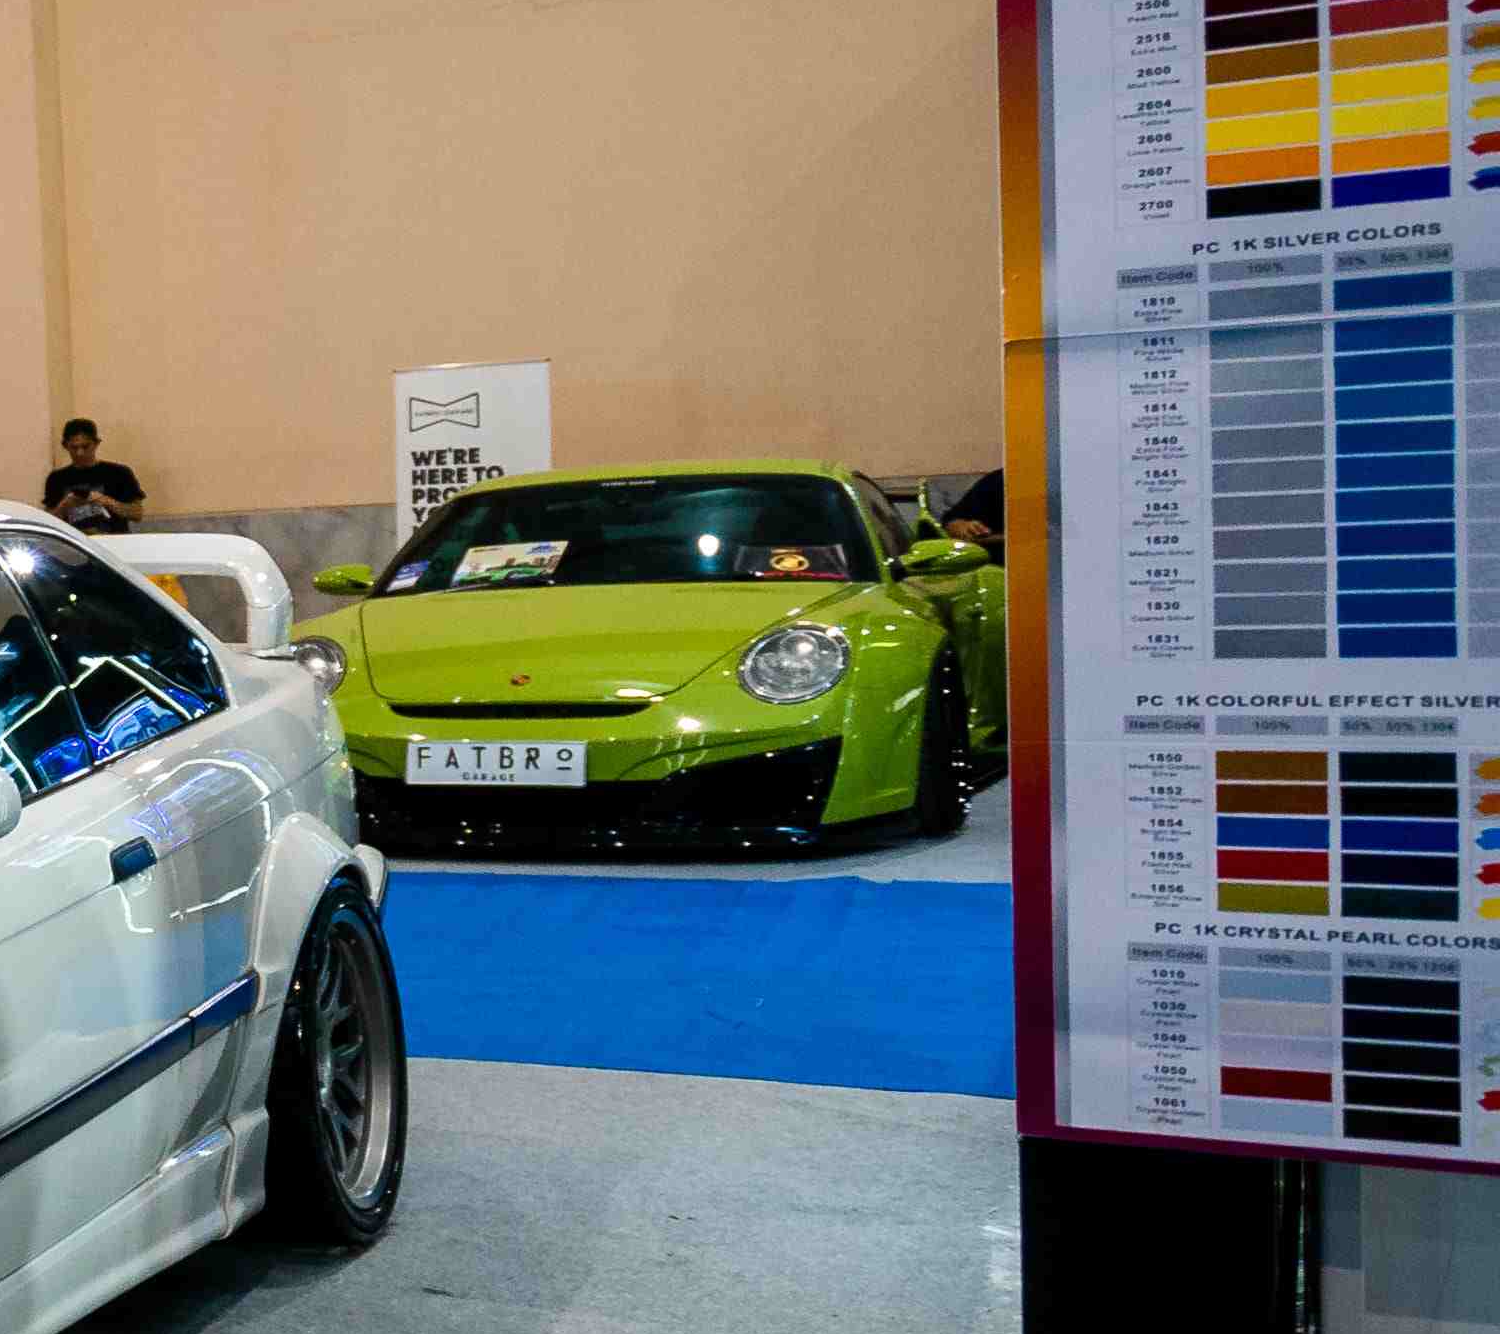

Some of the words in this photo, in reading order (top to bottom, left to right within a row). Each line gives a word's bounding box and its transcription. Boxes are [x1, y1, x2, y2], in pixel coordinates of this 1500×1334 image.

[1192, 241, 1219, 255] PC
[1233, 238, 1257, 251] 1K
[1264, 231, 1341, 249] SILVER
[1346, 222, 1442, 242] COLORS
[411, 447, 481, 467] WE'RE
[411, 468, 469, 486] HERE
[472, 465, 506, 482] TO
[412, 487, 472, 505] PRO
[1136, 694, 1164, 707] PC
[1175, 694, 1199, 707] 1K
[1206, 694, 1323, 708] COLORFUL
[1328, 695, 1414, 708] EFFECT
[417, 746, 573, 771] FATBRO
[461, 772, 517, 782] GARAGE
[1155, 922, 1182, 934] PC
[1194, 924, 1219, 936] 1K
[1223, 926, 1320, 942] CRYSTAL
[1327, 930, 1400, 946] PEARL
